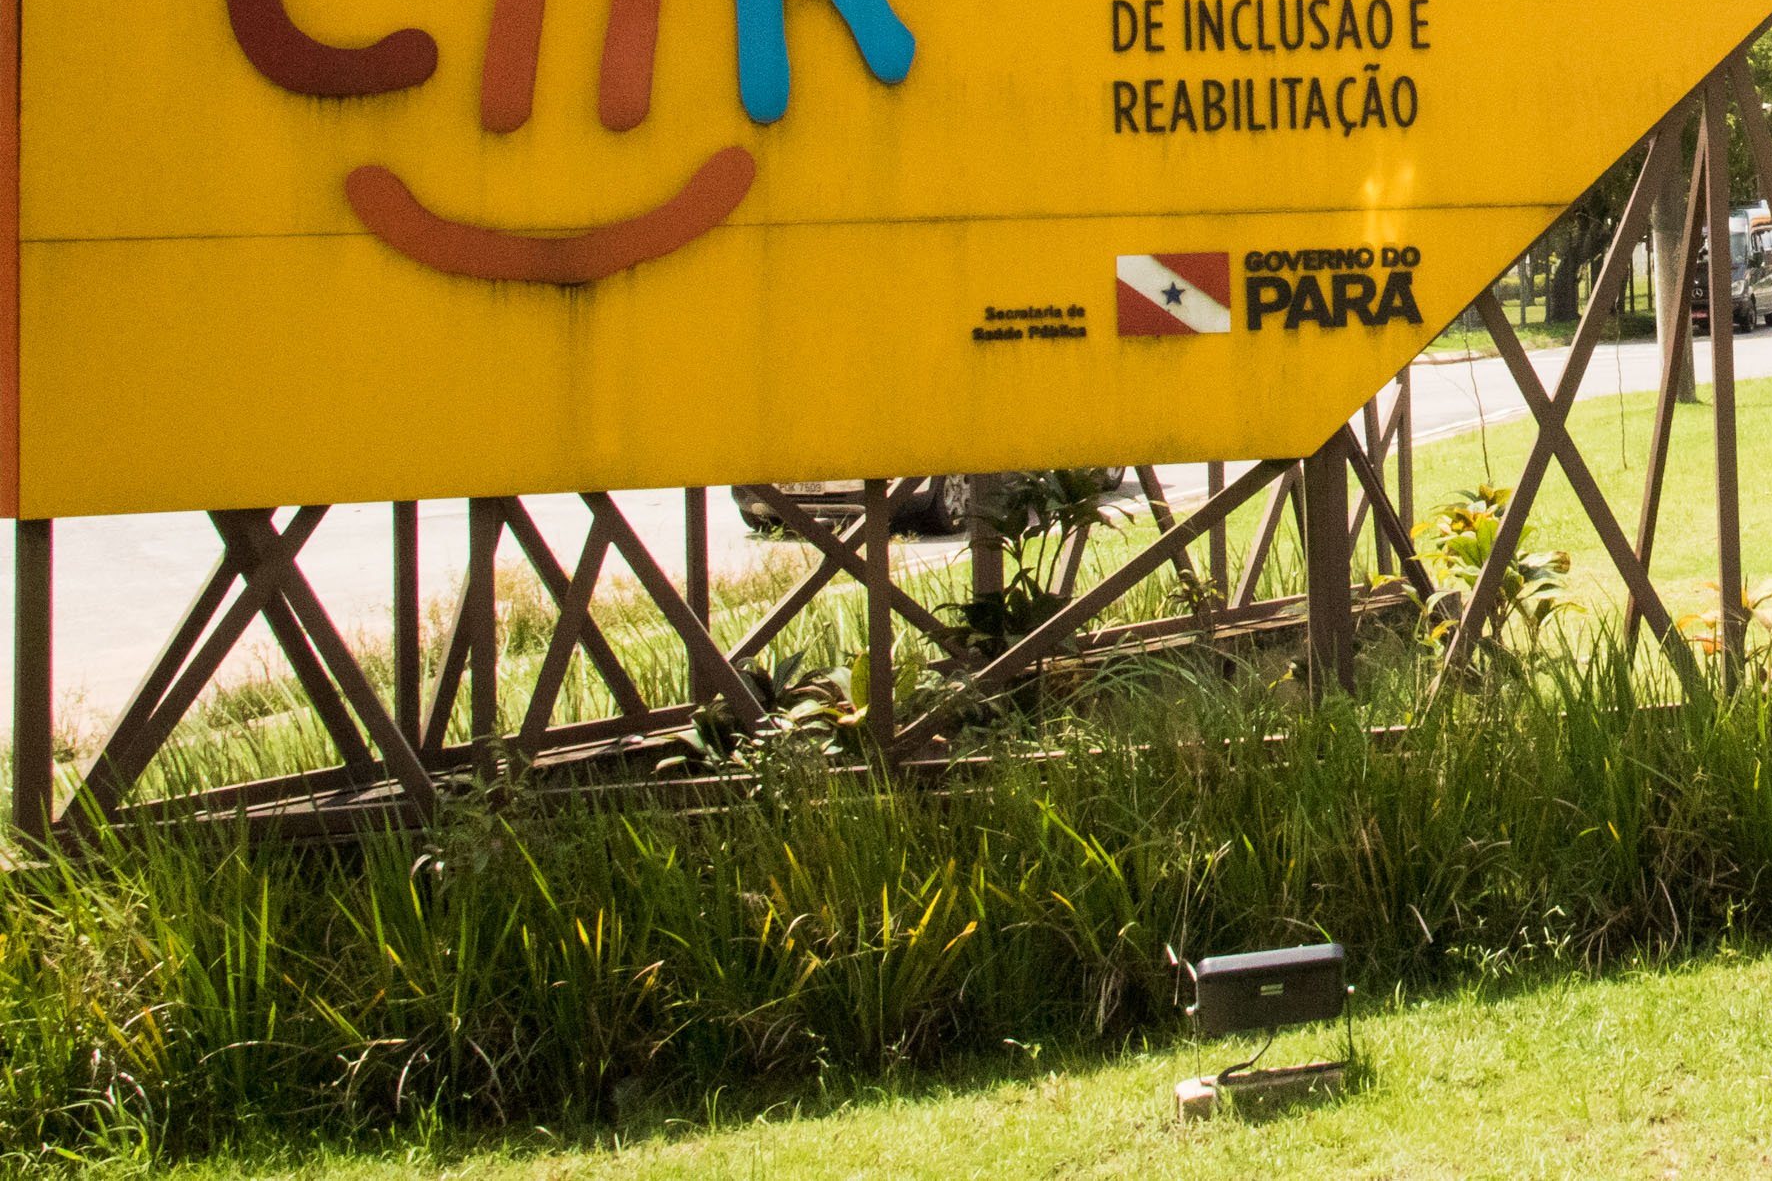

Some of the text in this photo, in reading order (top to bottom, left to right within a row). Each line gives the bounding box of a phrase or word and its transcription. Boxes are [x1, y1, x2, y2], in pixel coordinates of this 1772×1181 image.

[1111, 0, 1165, 52] DE
[1113, 63, 1418, 137] REABILITAÇÃO
[1244, 246, 1421, 272] GOVERNO DO
[985, 304, 1085, 321] Secretaria de
[1246, 271, 1425, 331] PARÁ
